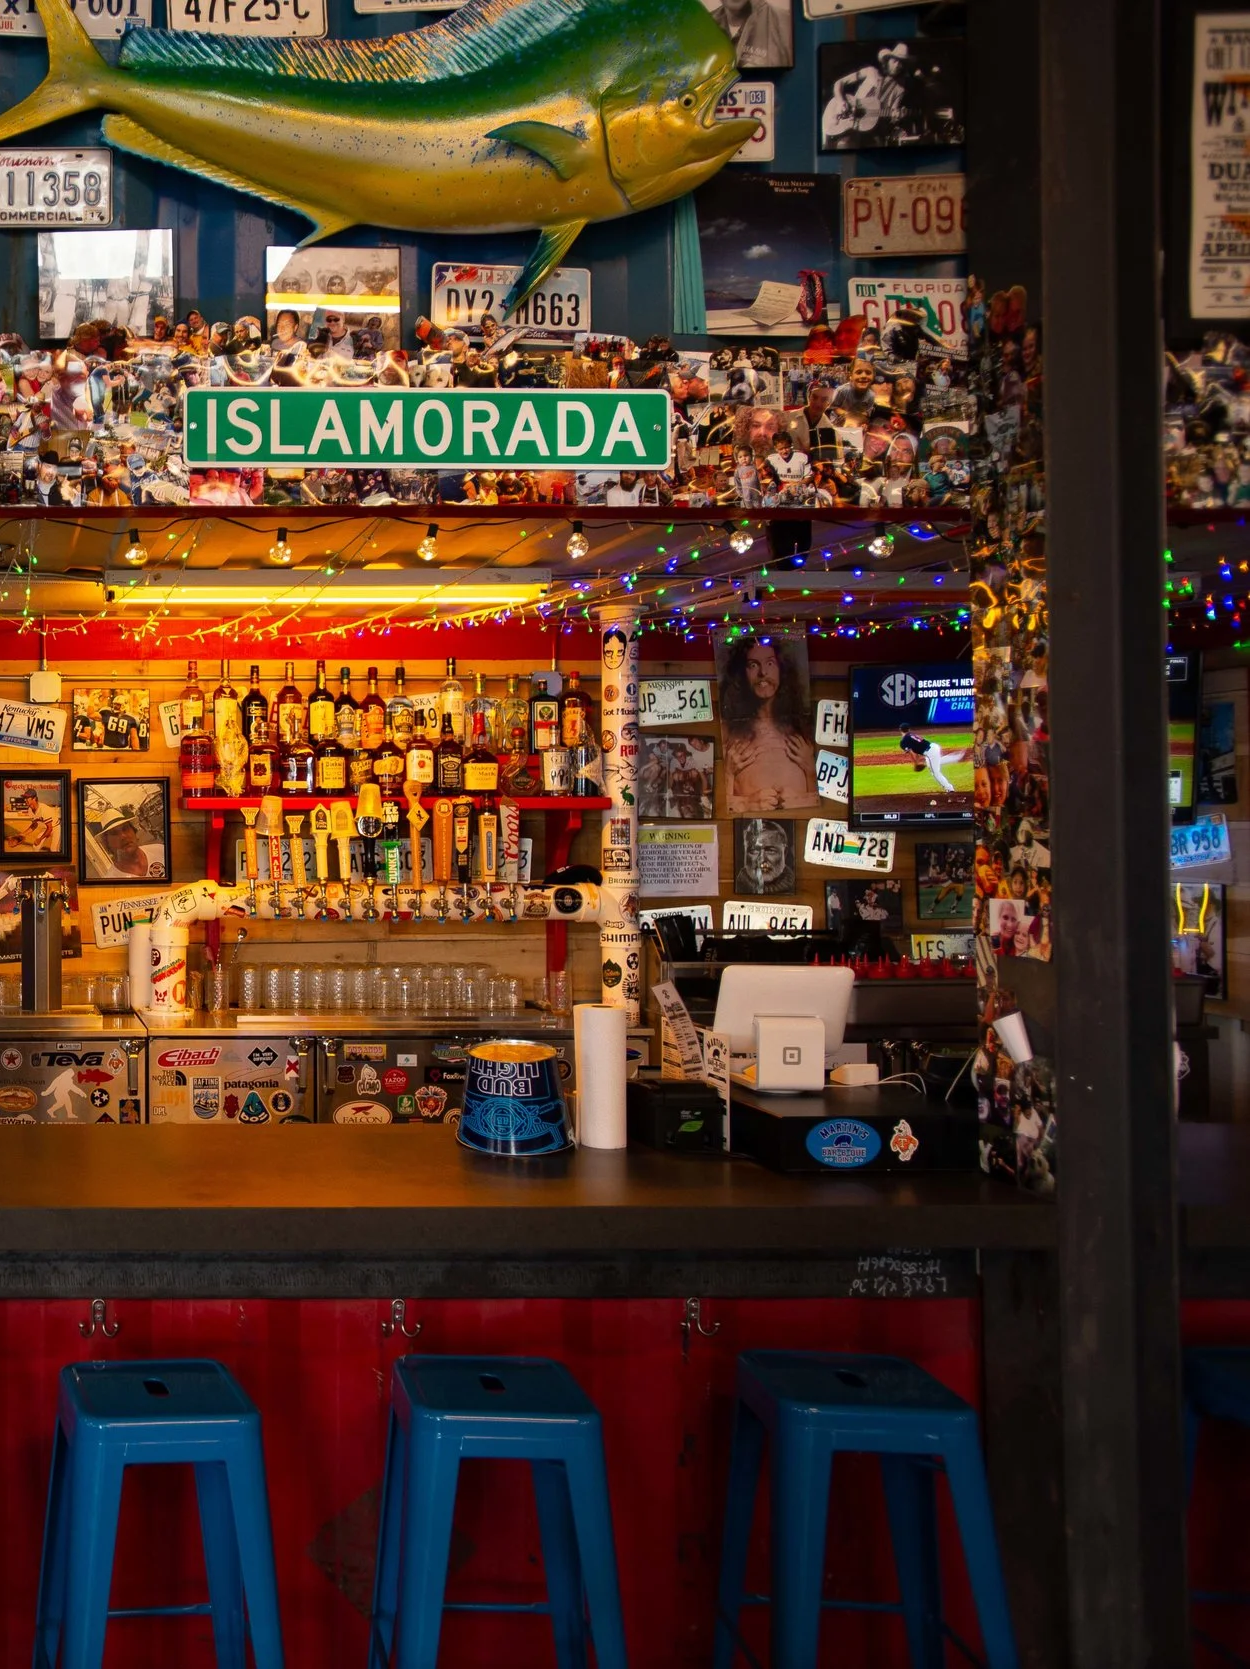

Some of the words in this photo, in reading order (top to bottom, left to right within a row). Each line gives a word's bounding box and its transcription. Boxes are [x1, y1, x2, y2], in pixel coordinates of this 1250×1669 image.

[908, 183, 948, 195] TENN
[893, 284, 964, 293] FLORIDA
[206, 398, 647, 457] ISLAMORADA
[881, 673, 916, 707] SEC
[918, 680, 951, 688] BECAUSE
[678, 689, 709, 711] 561
[918, 690, 938, 698] GOOD
[2, 704, 38, 717] Kentucky
[603, 708, 615, 716] Got
[26, 716, 56, 740] VMS
[107, 716, 128, 734] 69
[1, 735, 33, 745] JEFFERSON
[504, 803, 520, 861] Coors
[812, 831, 845, 853] AND
[857, 836, 889, 858] 728
[272, 861, 280, 878] ALE
[388, 847, 397, 883] DUNKEL
[117, 897, 159, 912] TENNESSEE
[100, 912, 133, 935] PUN
[605, 921, 626, 929] Jeep
[706, 1037, 727, 1056] MARTIN'S
[158, 1047, 220, 1066] Eibach
[472, 1058, 539, 1078] LIGHT
[223, 1079, 279, 1090] patagonia
[477, 1077, 532, 1096] BUD
[819, 1121, 870, 1140] MARTIN'S
